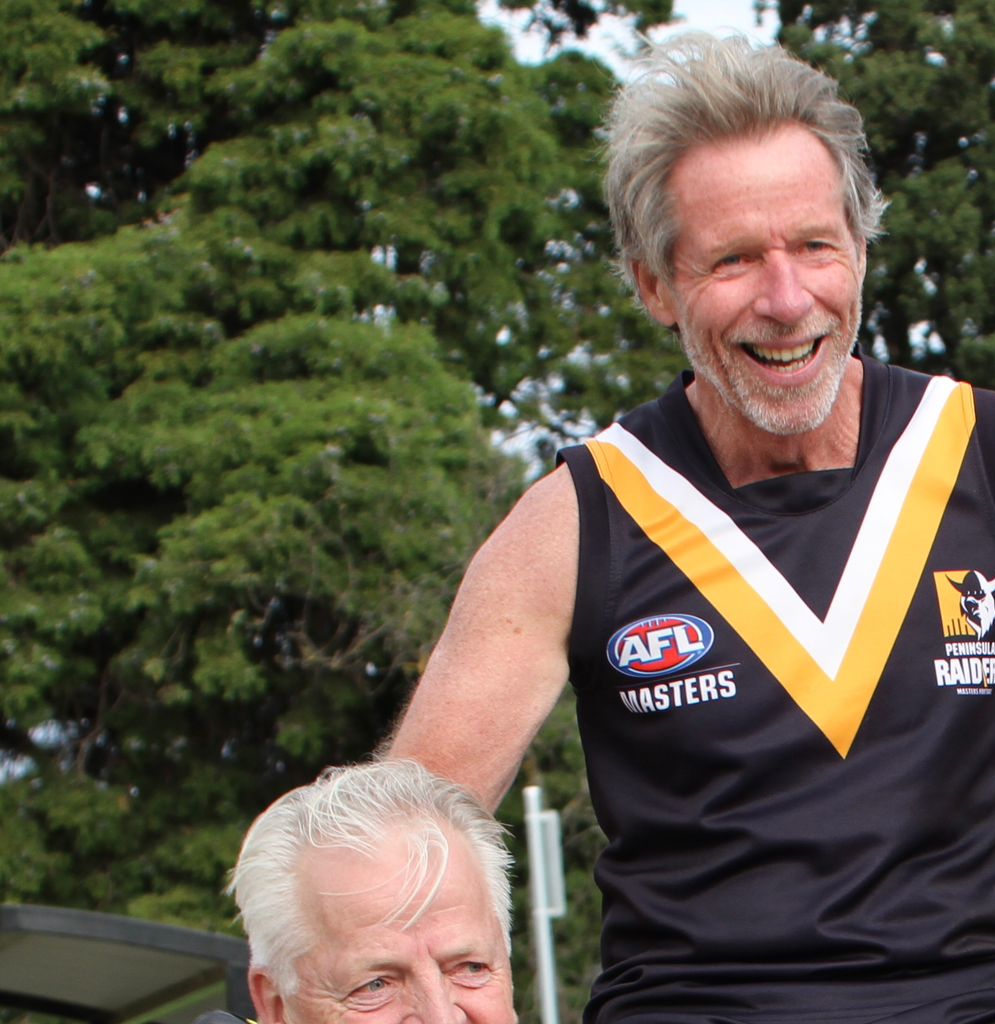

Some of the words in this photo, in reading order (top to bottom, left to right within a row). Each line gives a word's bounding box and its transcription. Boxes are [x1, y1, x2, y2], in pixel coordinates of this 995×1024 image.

[618, 624, 705, 667] AFL
[945, 642, 995, 656] PENINSULA
[620, 670, 737, 713] MASTERS
